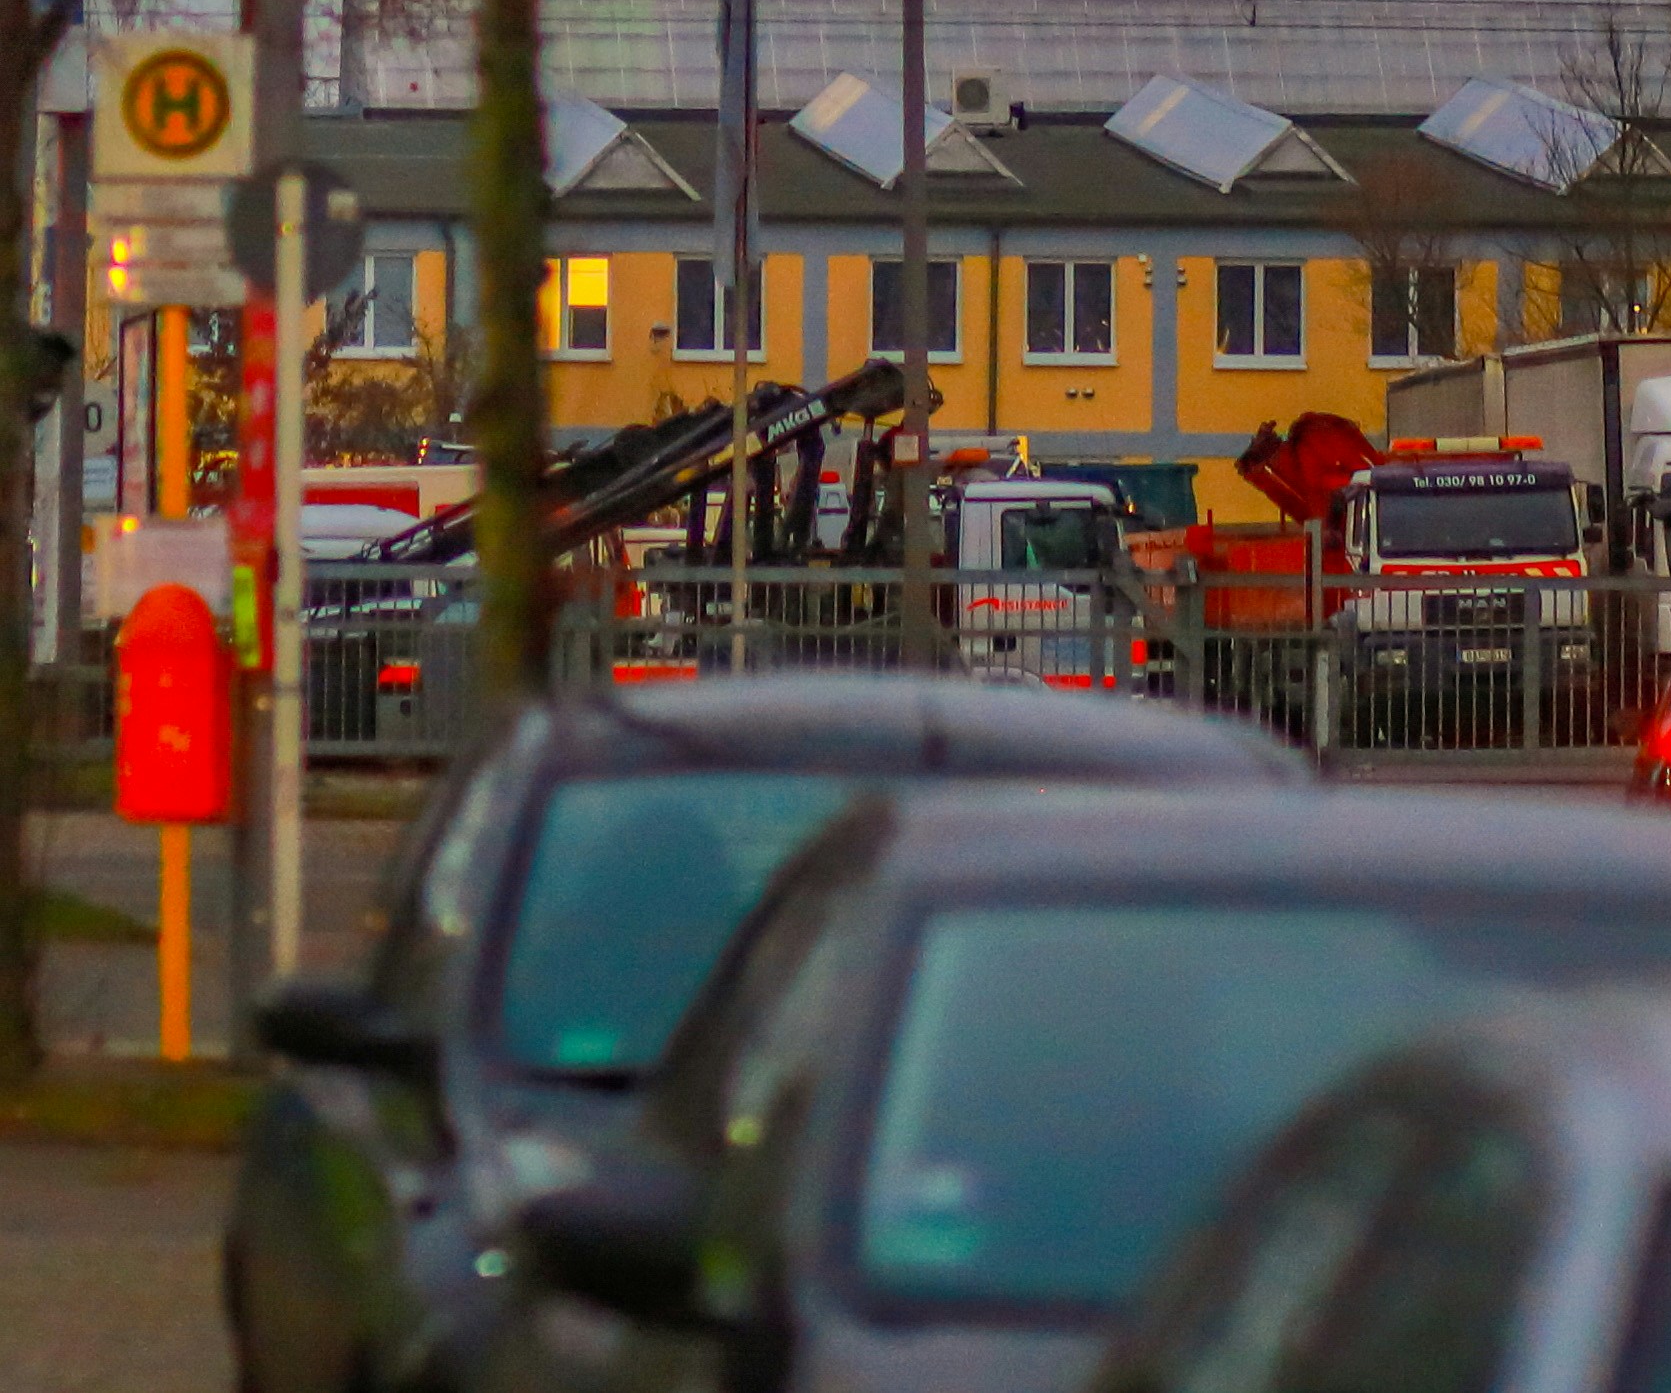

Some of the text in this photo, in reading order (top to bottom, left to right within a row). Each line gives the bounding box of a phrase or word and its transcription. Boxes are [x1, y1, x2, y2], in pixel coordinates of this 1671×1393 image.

[153, 70, 199, 131] H
[1412, 477, 1433, 488] Tel.
[1437, 475, 1465, 488] 030/
[1489, 474, 1504, 486] 10
[1458, 597, 1507, 609] MAN
